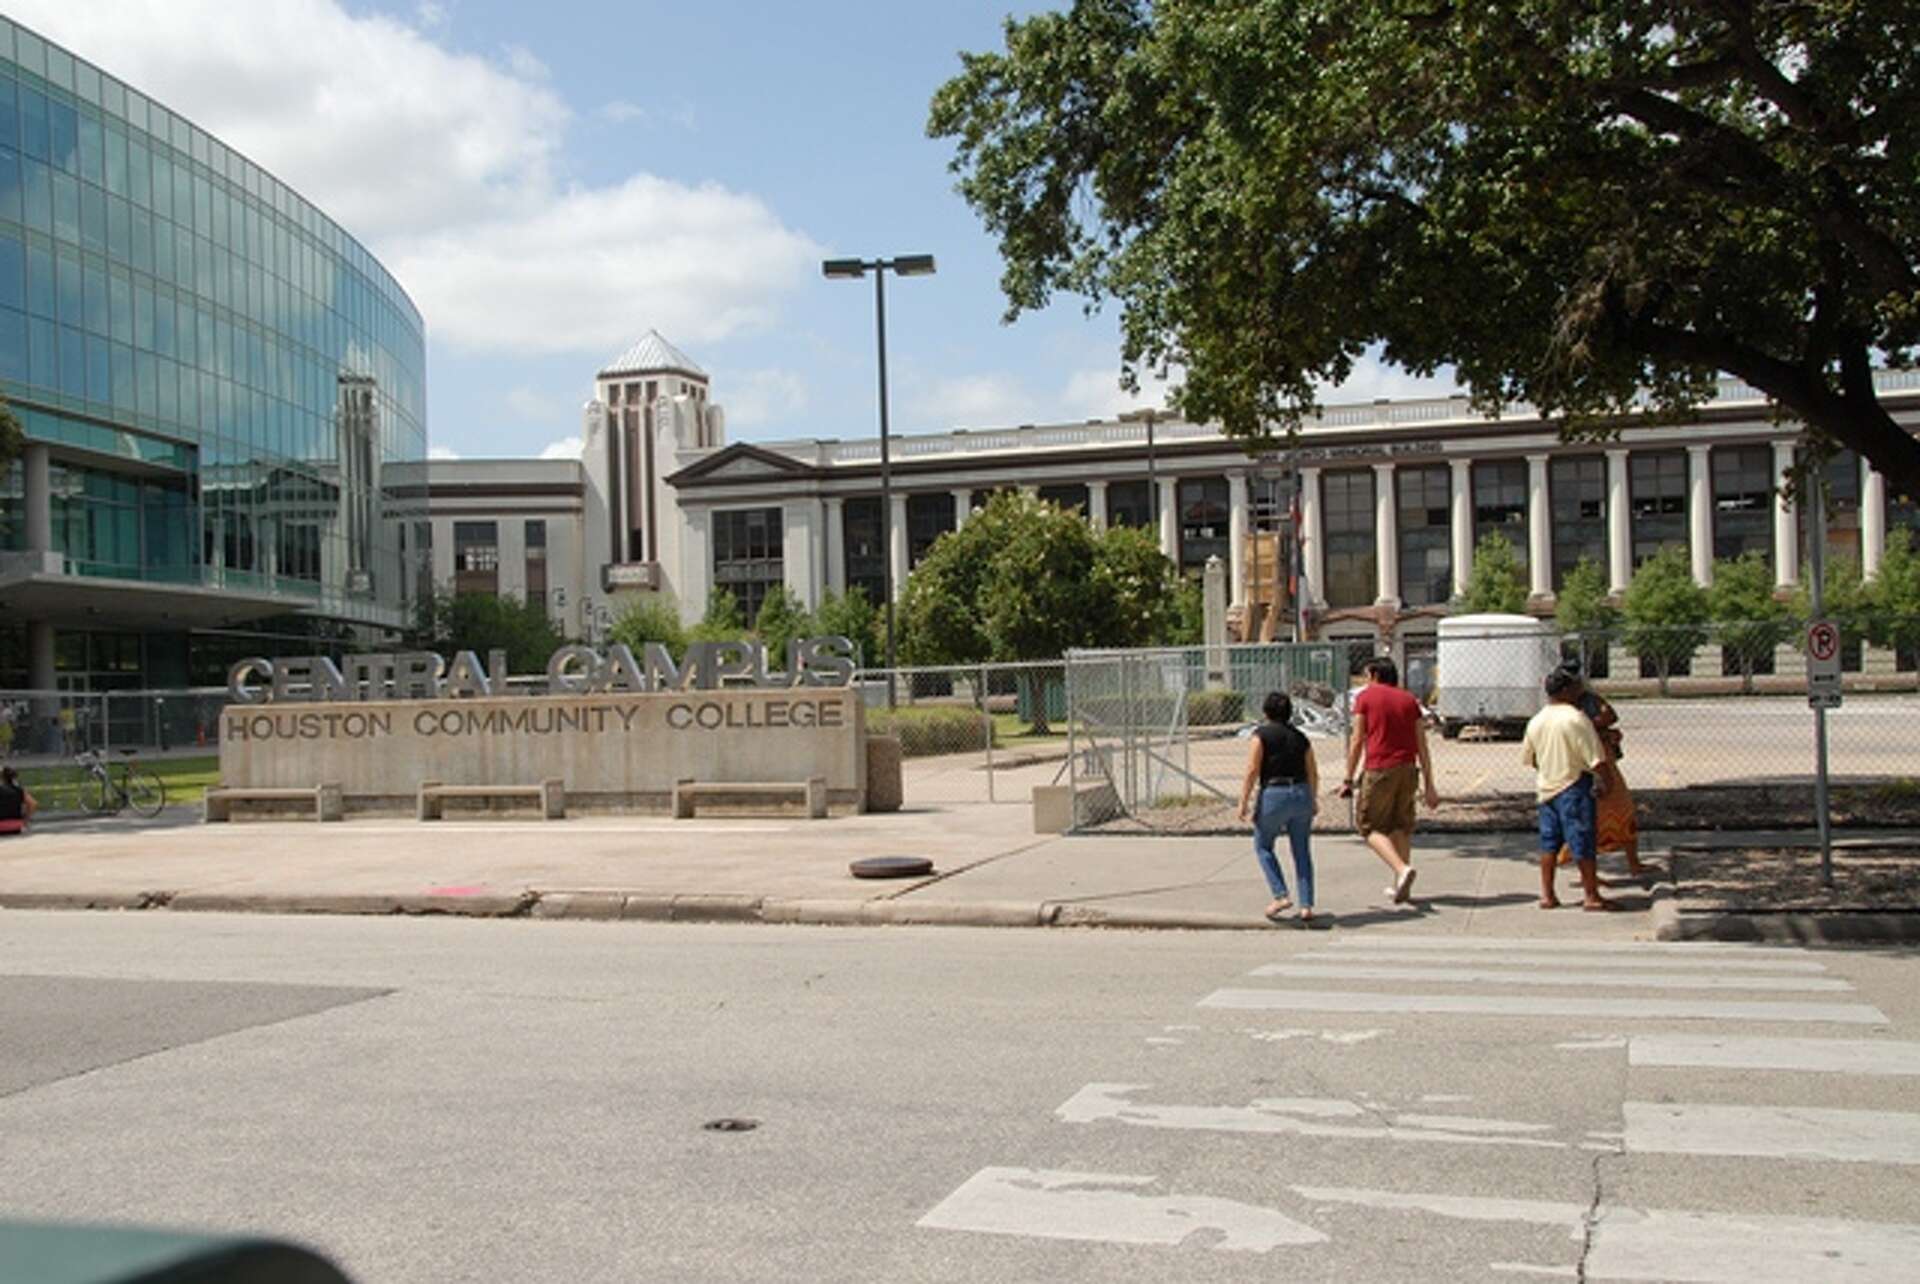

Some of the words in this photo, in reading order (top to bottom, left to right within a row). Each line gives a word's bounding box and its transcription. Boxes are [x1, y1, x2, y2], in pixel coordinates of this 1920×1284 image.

[229, 650, 528, 702] CENTRAL
[548, 636, 855, 694] CAMPUS
[227, 713, 390, 742] HOUSTON
[413, 705, 639, 736] COMMUNITY
[666, 701, 842, 730] COLLEGE
